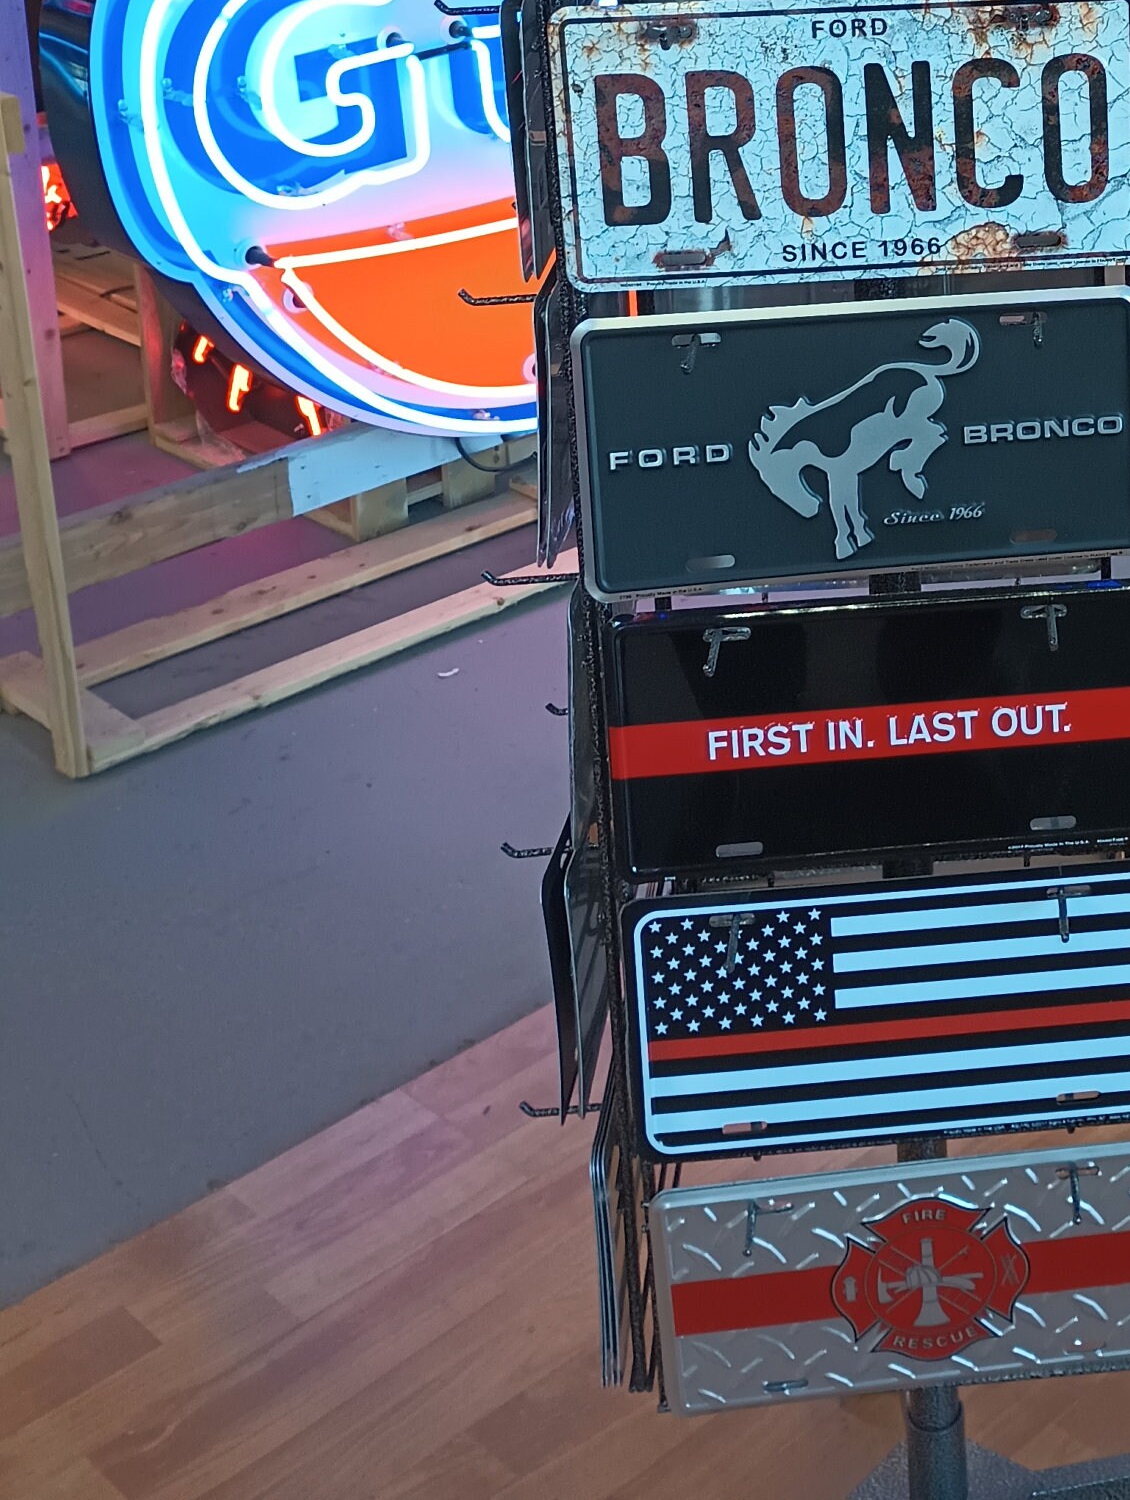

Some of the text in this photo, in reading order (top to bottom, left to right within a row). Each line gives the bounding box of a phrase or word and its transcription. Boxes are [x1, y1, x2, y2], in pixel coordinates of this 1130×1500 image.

[811, 17, 888, 38] FORD
[594, 54, 1110, 227] BRONCO
[782, 237, 941, 263] SINCE 1966
[609, 415, 1122, 470] FORD BRONCO
[882, 503, 984, 527] Since 1966
[707, 702, 1072, 761] FIRST IN. LAST OUT.
[902, 1209, 947, 1225] FIRE
[893, 1327, 976, 1349] RESCUE
